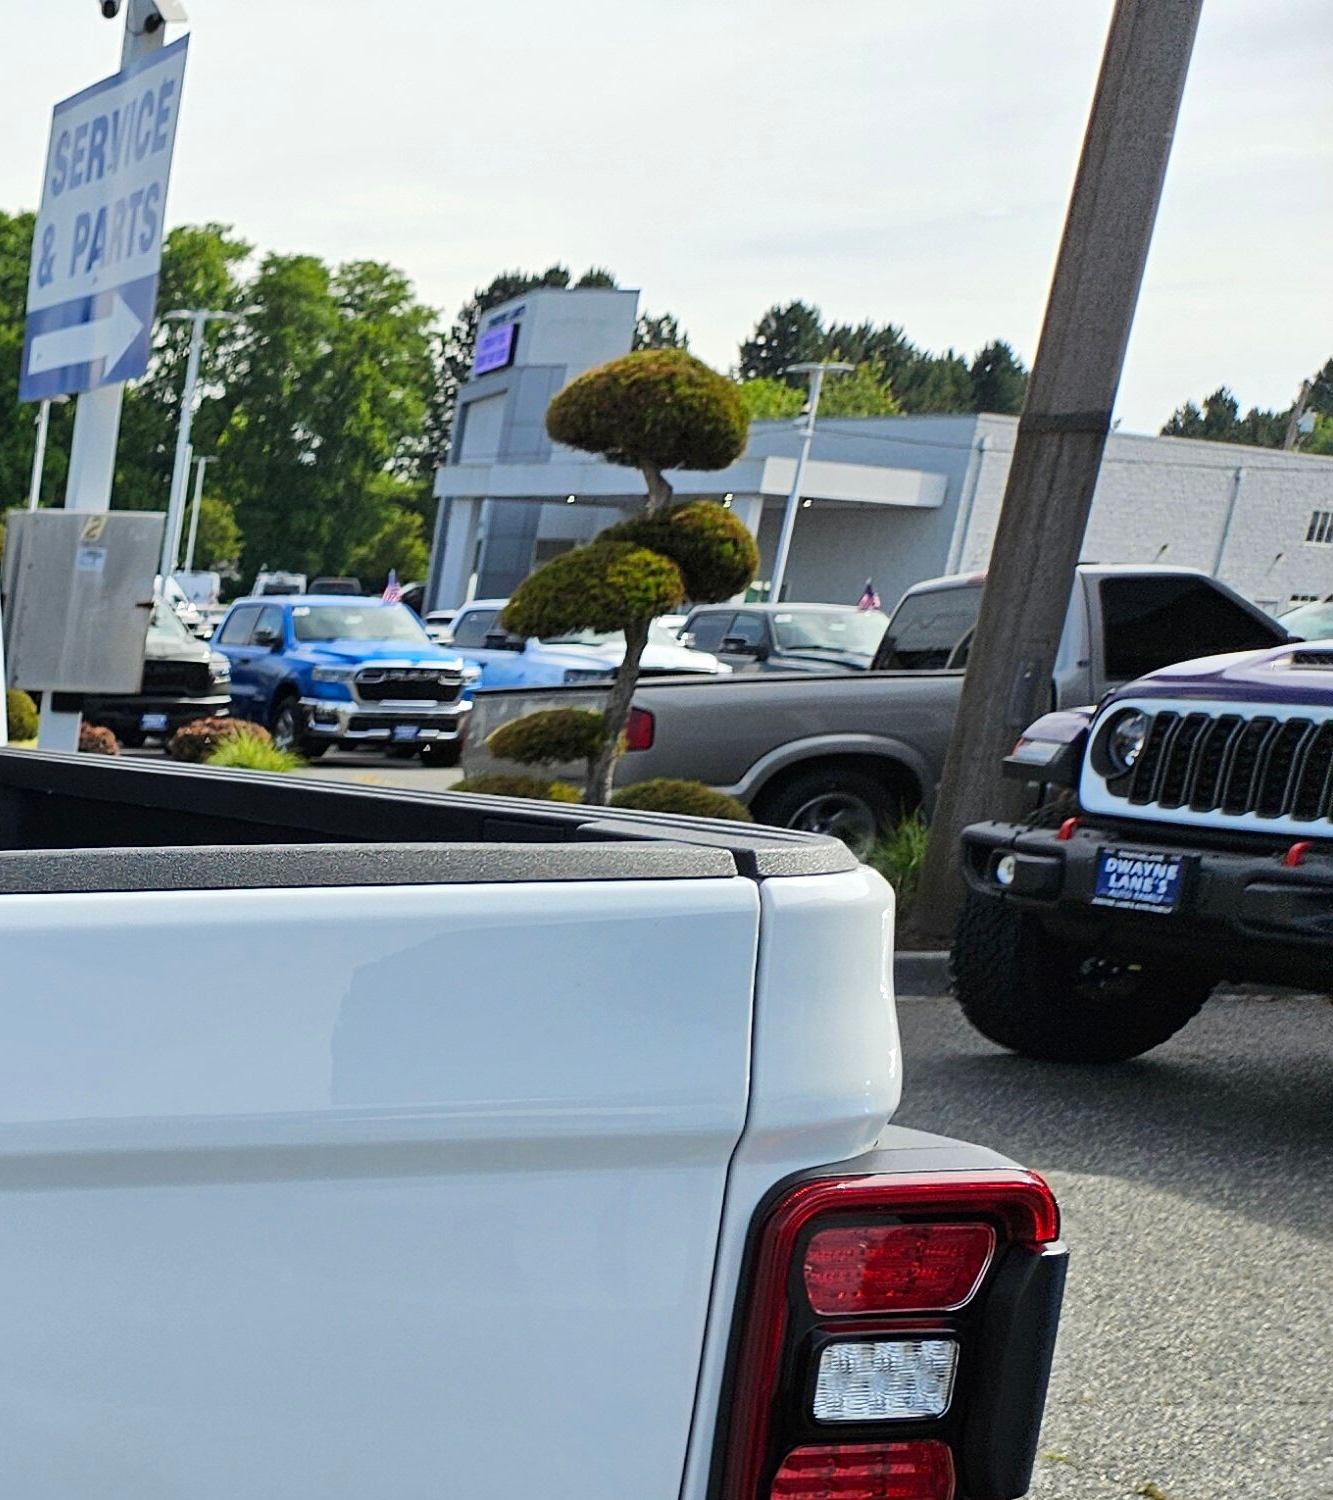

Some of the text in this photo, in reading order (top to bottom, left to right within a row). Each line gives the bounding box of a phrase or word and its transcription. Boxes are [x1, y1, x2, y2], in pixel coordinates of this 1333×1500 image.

[50, 79, 176, 197] SERVICE
[37, 182, 160, 289] & PARTS
[1105, 857, 1179, 880] DWAYNE
[1108, 873, 1168, 894] LANE'S
